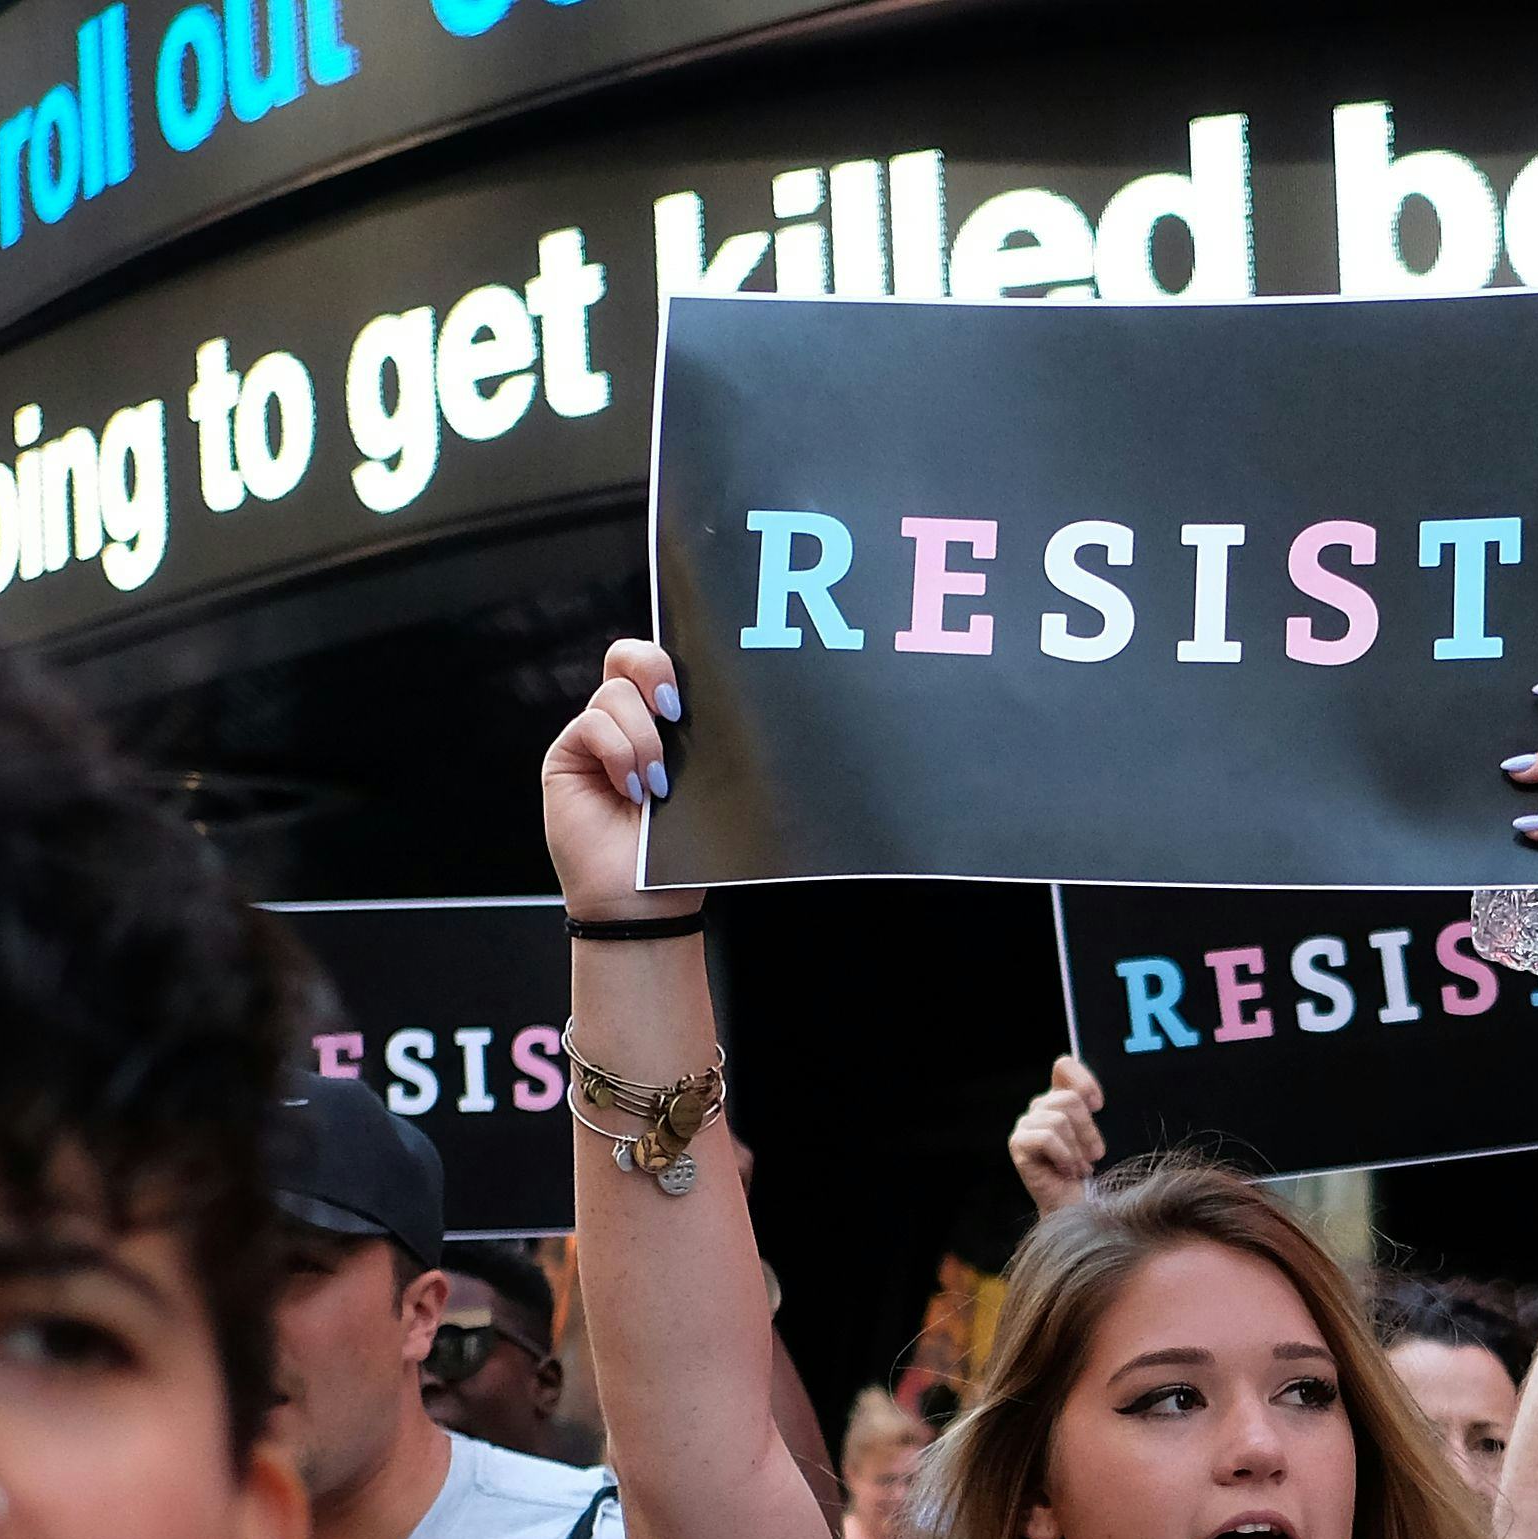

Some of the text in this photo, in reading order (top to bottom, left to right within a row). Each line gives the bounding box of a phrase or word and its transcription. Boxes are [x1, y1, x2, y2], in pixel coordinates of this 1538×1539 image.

[187, 337, 317, 513] to
[345, 227, 611, 514] get
[653, 112, 1256, 298] killed
[738, 509, 1523, 666] RESIST
